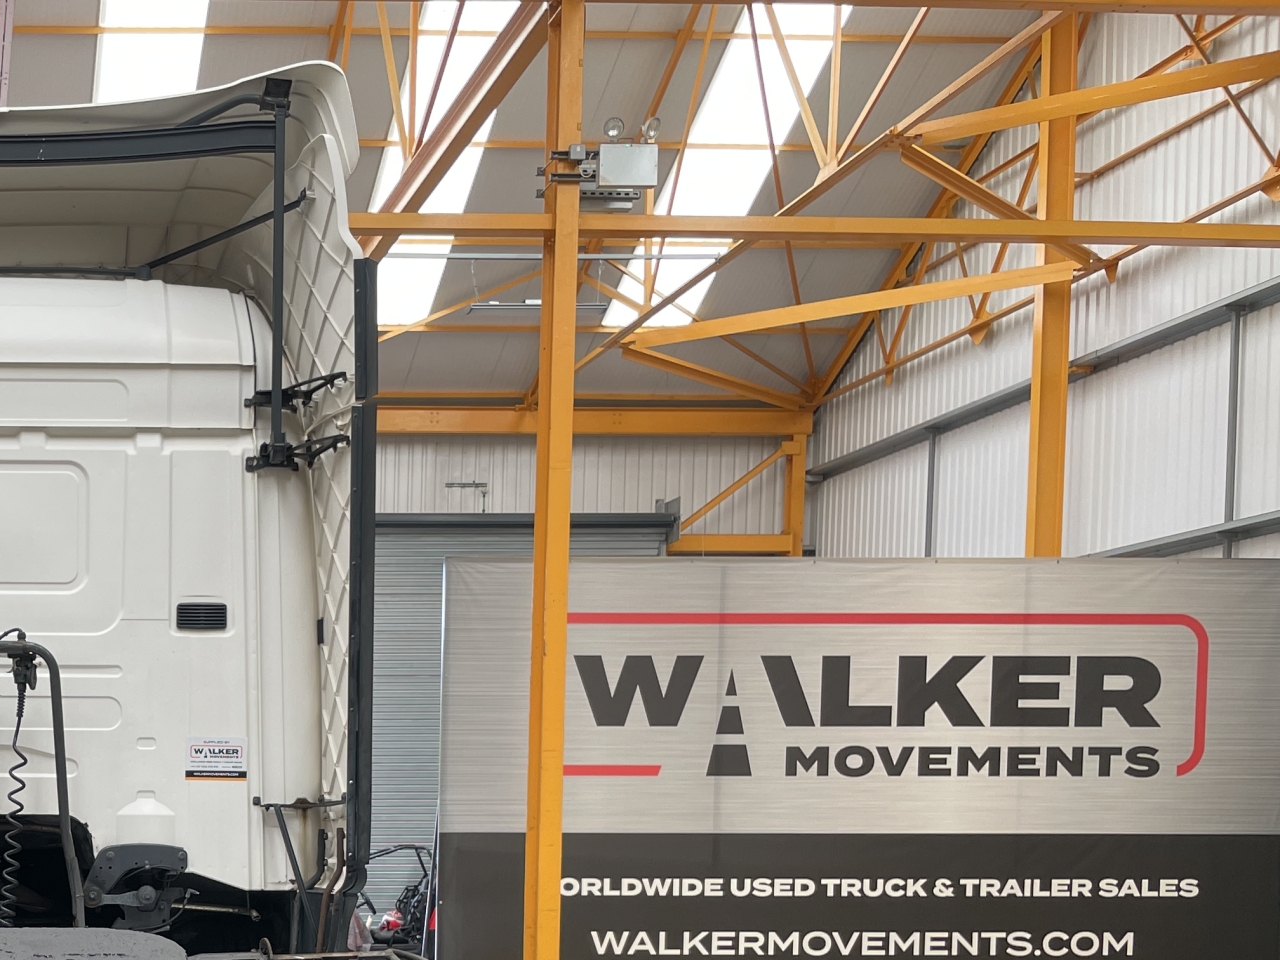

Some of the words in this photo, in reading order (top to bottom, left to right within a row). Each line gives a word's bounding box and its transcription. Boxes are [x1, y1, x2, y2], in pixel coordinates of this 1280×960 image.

[573, 655, 1162, 778] WALKER
[194, 748, 239, 758] WALKER
[786, 746, 1160, 778] MOVEMENTS
[561, 878, 723, 896] ORLDWIDE
[731, 878, 815, 896] USED
[821, 879, 927, 897] TRUCK
[933, 879, 954, 897] &
[960, 879, 1092, 896] TRAILER
[1099, 879, 1199, 897] SALES
[591, 931, 1133, 956] WALKERMOVEMENTS.COM
